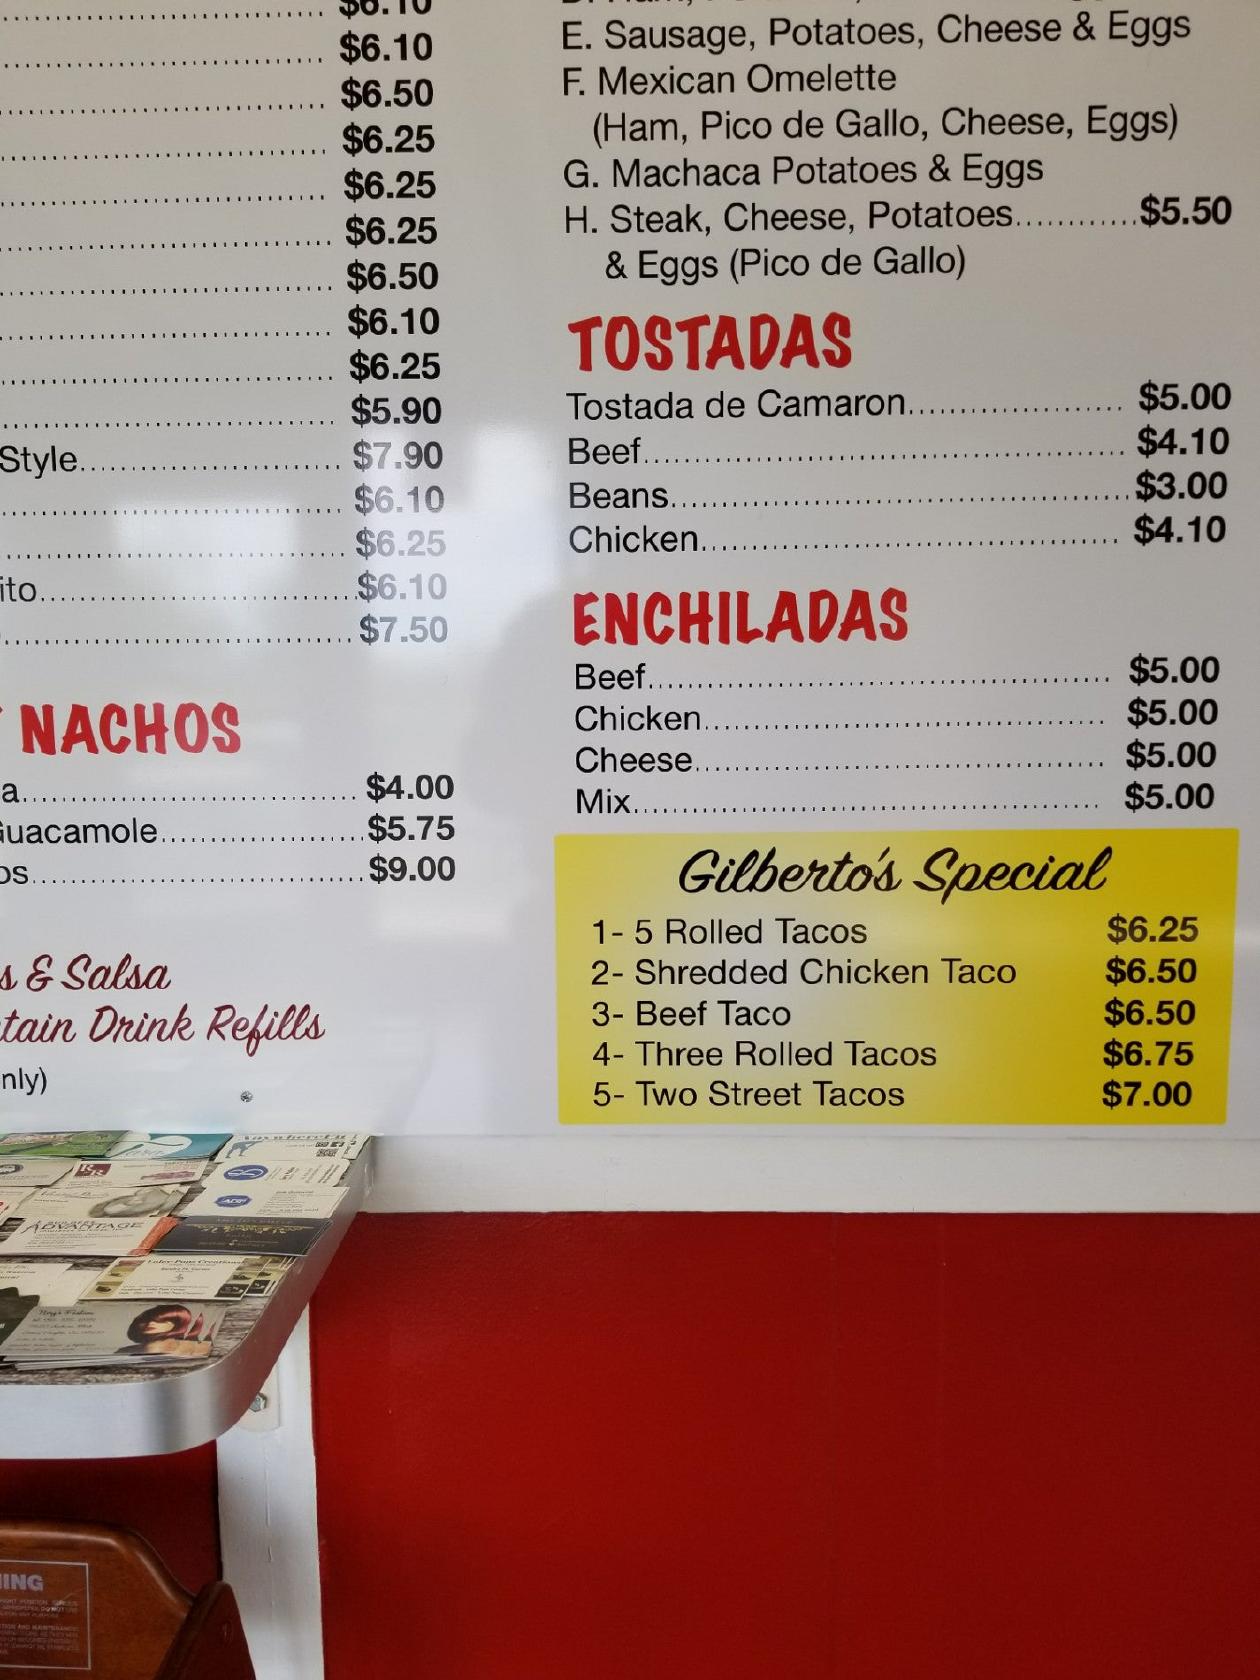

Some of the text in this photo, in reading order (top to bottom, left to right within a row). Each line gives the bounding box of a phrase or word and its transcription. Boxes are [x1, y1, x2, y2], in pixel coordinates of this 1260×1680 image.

[340, 30, 432, 65] $6.10
[563, 10, 1190, 55] E. Sausage, Potatoes, Cheese & Eggs
[341, 76, 433, 111] $6.50
[563, 64, 896, 95] F. Mexican Omelette
[343, 122, 435, 157] $6.25
[594, 104, 1177, 149] (Ham, Pico de Gallo, Cheese, Eggs)
[344, 168, 436, 203] $6.25
[564, 153, 1043, 188] G. Machaca Potatoes & Eggs
[346, 214, 437, 248] $6.25
[566, 193, 1232, 236] H. Steak, Cheese, Potatoes $5.50
[347, 259, 438, 294] $6.50
[606, 245, 965, 286] & Eggs (Pico de Gallo)
[348, 304, 439, 339] $6.10
[568, 312, 851, 371] TOSTADAS
[350, 349, 440, 384] $6.25
[352, 394, 441, 428] $5.90
[566, 380, 1231, 420] Tostada de Camaron $5.00
[0, 439, 443, 479] Style $7.90
[569, 424, 1229, 464] Beef $4.10
[355, 483, 444, 516] $6.10
[570, 469, 1227, 508] Beans $3.00
[356, 527, 446, 560] $6.25
[570, 513, 1226, 553] Chicken $4.10
[358, 570, 446, 603] $6.10
[360, 614, 447, 645] $7.50
[574, 588, 907, 646] ENCHILADAS
[576, 653, 1219, 690] Beef $5.00
[20, 702, 240, 755] NACHOS
[576, 696, 1218, 731] Chicken $5.00
[576, 738, 1216, 773] Cheese $5.00
[367, 772, 454, 803] $4.00
[577, 781, 1214, 813] Mix $5.00
[0, 813, 455, 844] uacamole $5.75
[370, 853, 455, 884] $9.00
[679, 846, 1112, 905] Gilberto's Special
[593, 913, 1198, 945] 1- 5 Rolled Tacos $6.25
[26, 954, 53, 992] &
[61, 953, 171, 990] Salsa
[592, 955, 1196, 987] 2- Shredded Chicken Taco $6.50
[89, 1003, 194, 1043] Drink
[207, 1004, 325, 1057] Refills
[592, 997, 1195, 1028] 3- Beef Taco $6.50
[593, 1038, 1193, 1069] 4- Three Rolled Tacos $6.75
[594, 1079, 1192, 1110] 5- Two Street Tacos $7.00
[0, 1573, 43, 1592] ING
